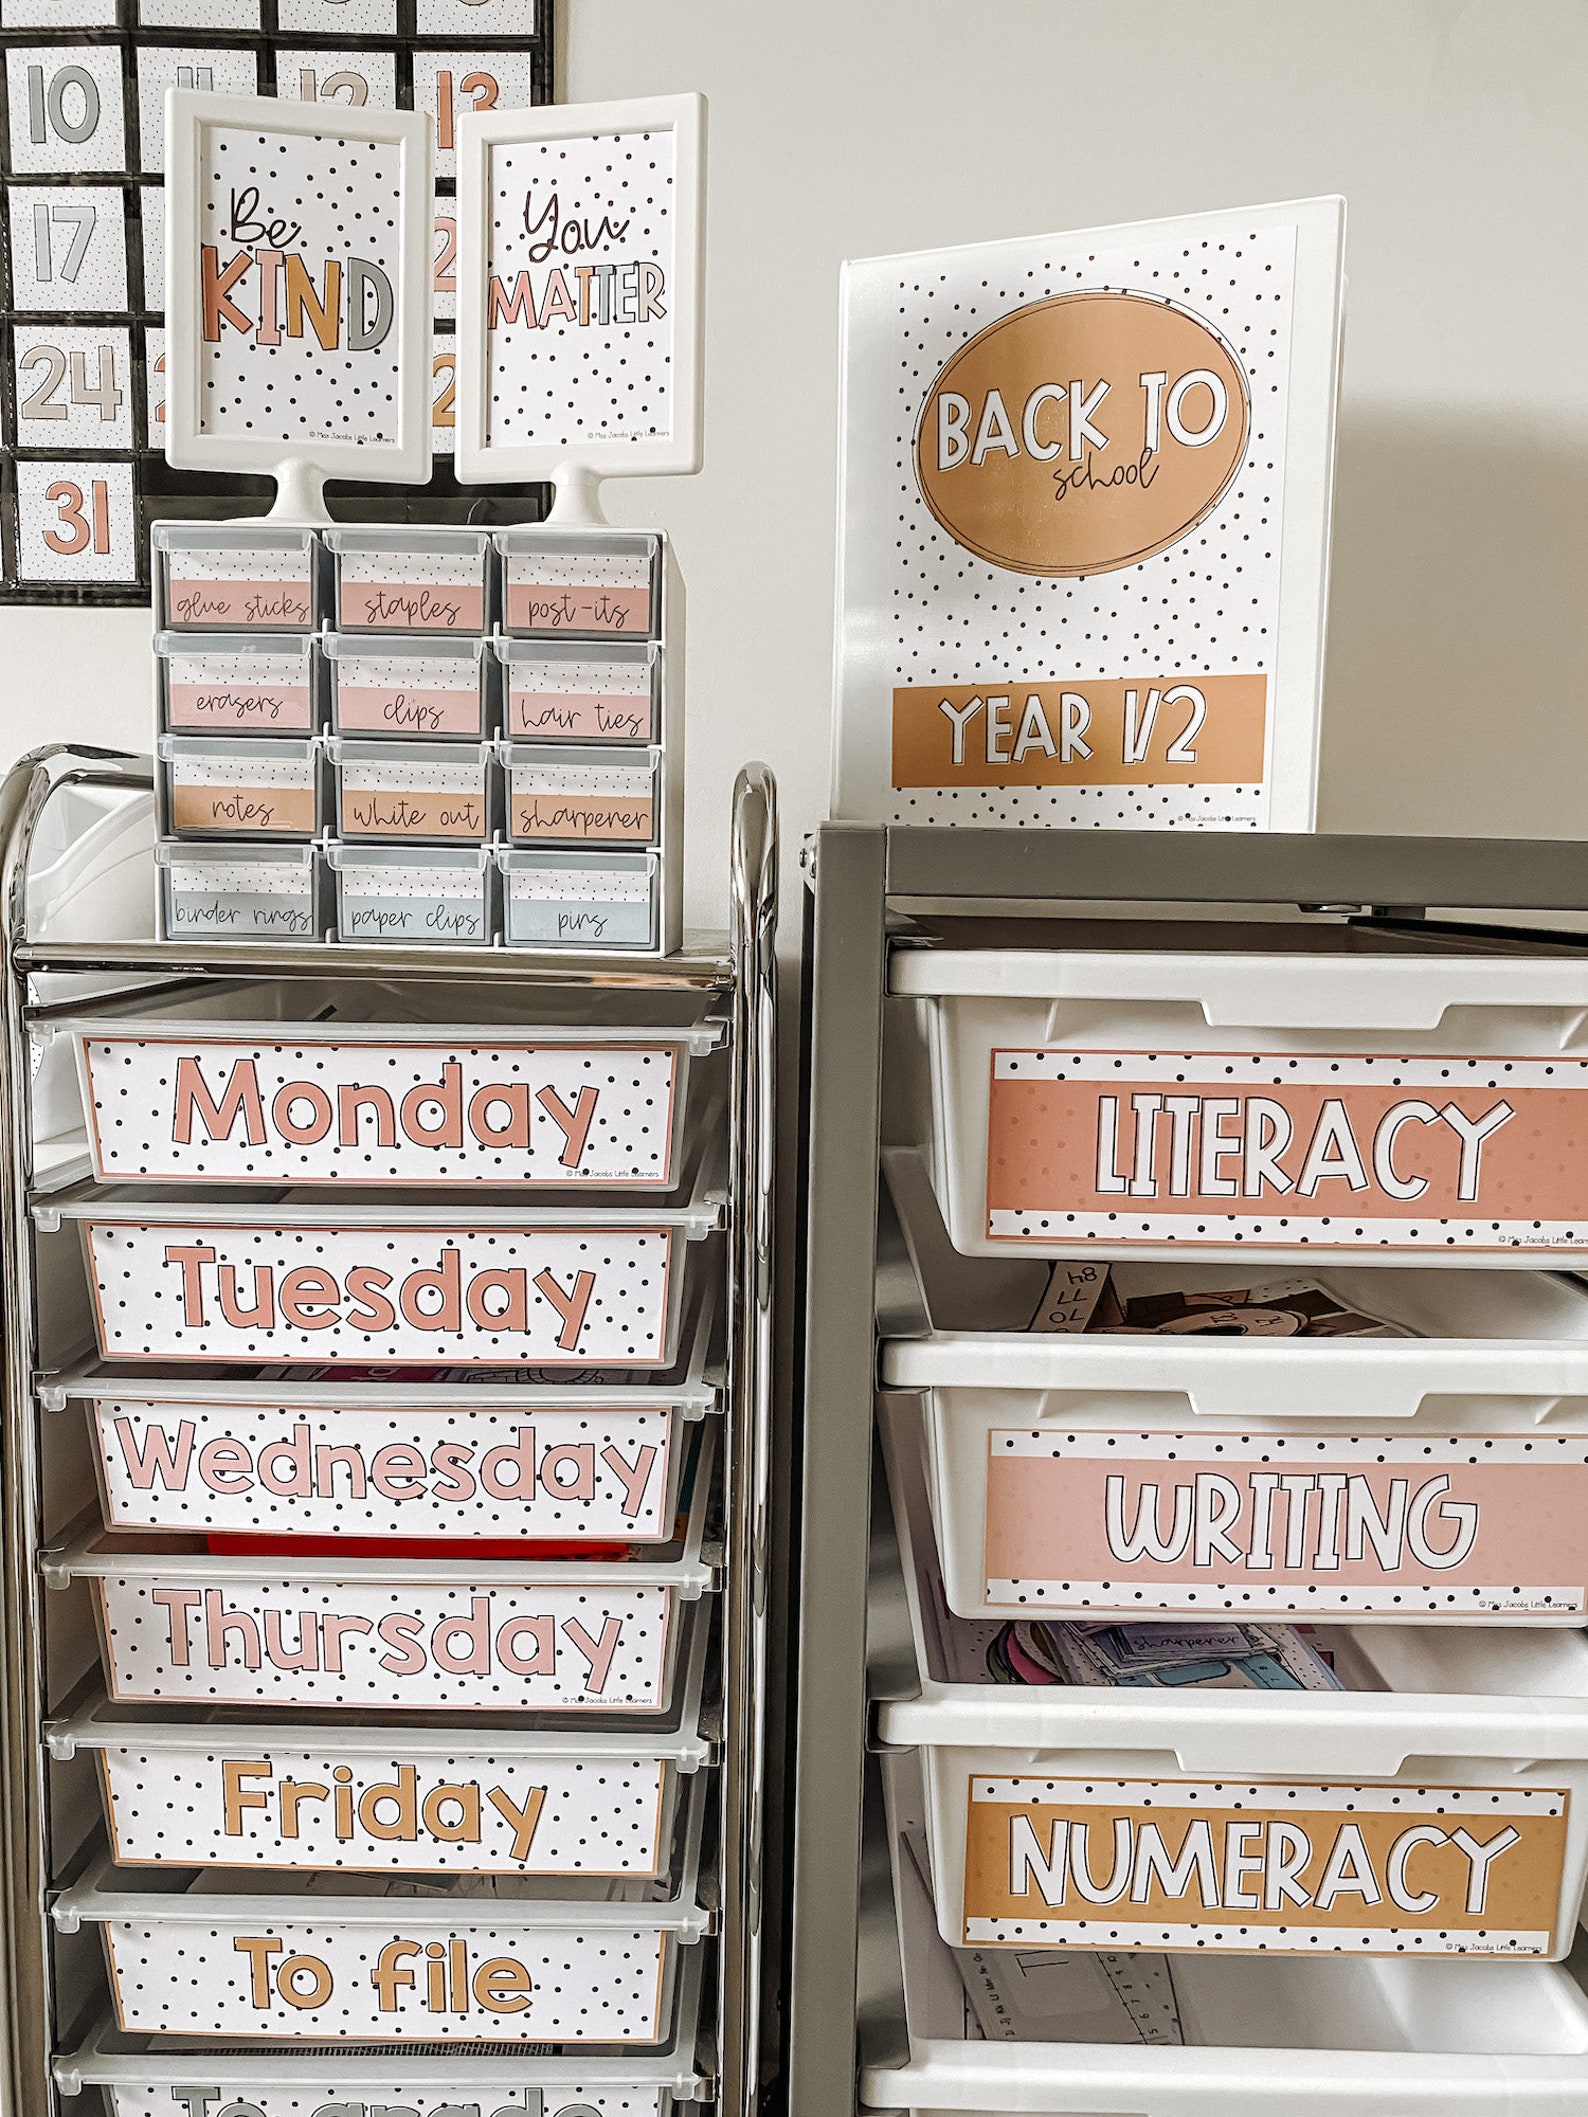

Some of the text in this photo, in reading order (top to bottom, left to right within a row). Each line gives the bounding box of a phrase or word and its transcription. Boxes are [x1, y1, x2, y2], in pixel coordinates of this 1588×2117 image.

[28, 65, 100, 144] 10
[34, 204, 96, 283] 17
[230, 186, 302, 250] Be
[523, 190, 630, 263] You
[201, 243, 394, 351] KIND
[488, 261, 667, 331] MATTER
[19, 345, 122, 421] 24
[937, 369, 1228, 471] BACK TO
[1053, 448, 1160, 502] school
[42, 480, 110, 555] 31
[176, 590, 311, 623] glue sticks
[364, 590, 461, 627] staples
[527, 594, 630, 631] post-its
[196, 693, 283, 719] erasers
[383, 694, 445, 730] clips
[521, 699, 645, 737] hair ties
[938, 689, 1093, 765] YEAR
[212, 794, 274, 827] notes
[353, 799, 481, 831] white out
[519, 800, 649, 837] sharpener
[176, 898, 313, 938] binder rings
[351, 902, 481, 935] paper clips
[557, 910, 608, 937] pins
[171, 1056, 600, 1168] Monday
[589, 1169, 613, 1177] Jacobs
[614, 1169, 629, 1177] Little
[1096, 1093, 1516, 1202] LITERACY
[1524, 1235, 1550, 1244] Jacobs
[1552, 1236, 1568, 1245] Little
[165, 1245, 597, 1351] Tuesday
[113, 1416, 658, 1518] Wednesday
[1106, 1472, 1479, 1573] WRITING
[1503, 1600, 1529, 1608] Jacobs
[1530, 1600, 1546, 1608] Little
[152, 1588, 623, 1694] Thursday
[1133, 1635, 1240, 1650] sharpener
[585, 1696, 607, 1704] Jacobs
[221, 1760, 547, 1862] Friday
[1009, 1813, 1521, 1915] NUMERACY
[234, 1937, 534, 2014] To file
[1470, 1943, 1494, 1951] Jacobs
